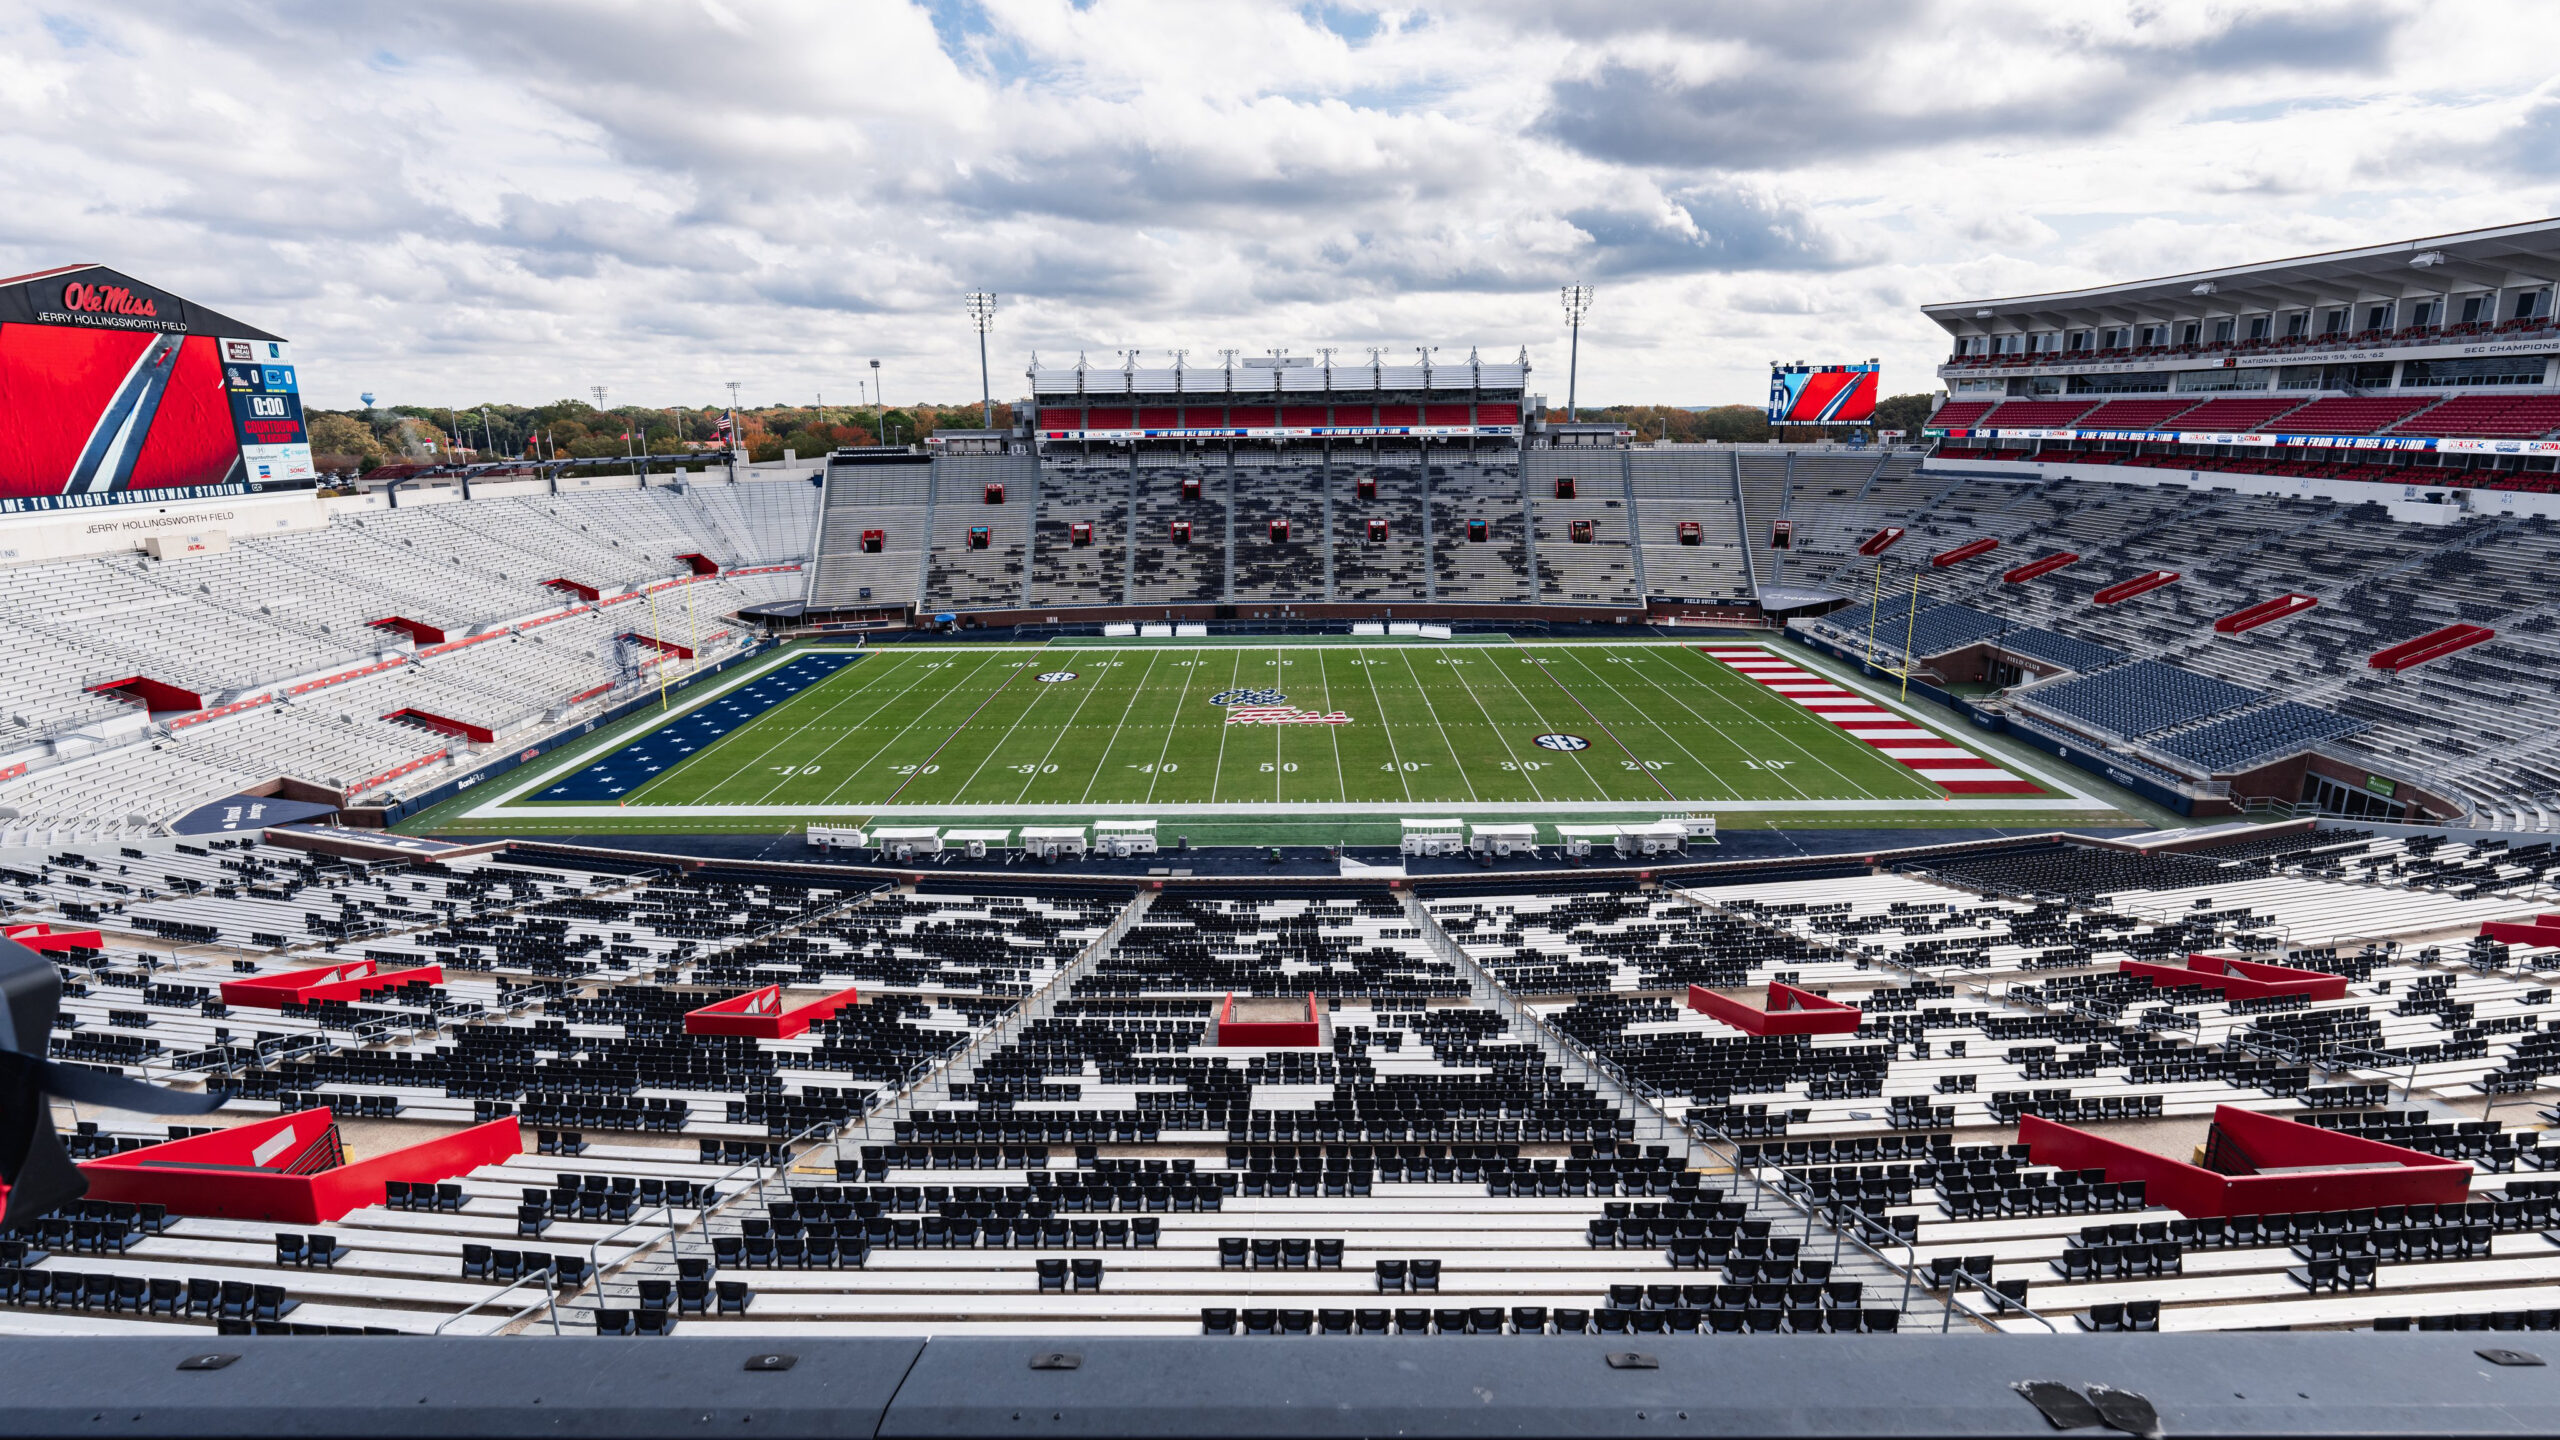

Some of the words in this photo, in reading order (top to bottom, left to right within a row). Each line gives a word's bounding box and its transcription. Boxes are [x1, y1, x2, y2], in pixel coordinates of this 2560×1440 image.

[64, 282, 102, 312] Ole
[98, 285, 157, 317] Miss
[37, 312, 72, 323] JERRY
[74, 314, 160, 329] HOLLINGSWORTH
[161, 321, 187, 331] FIELD
[2463, 346, 2486, 354] SEC
[2489, 342, 2560, 352] CHAMPIONS
[2224, 358, 2234, 367] 25
[2242, 357, 2279, 365] NATIONAL
[2281, 355, 2329, 363] CHAMPIONS
[251, 369, 259, 384] 0
[284, 371, 293, 384] 0
[253, 397, 285, 416] 0:00
[244, 420, 300, 433] COUNTDOWN
[1975, 429, 1991, 438] 0:00
[2081, 431, 2098, 439] LIVE
[2099, 432, 2116, 440] FROM
[2117, 432, 2129, 440] OLE
[2287, 436, 2306, 446] LIVE
[2307, 437, 2333, 447] FROM
[2335, 438, 2353, 448] OLE
[2354, 439, 2380, 449] MISS
[33, 496, 50, 511] TO
[57, 485, 191, 509] VAUGHT-HEMINGWAY
[195, 482, 245, 497] STADIUM
[86, 522, 119, 534] JERRY
[122, 513, 208, 529] HOLLINGSWORTH
[209, 511, 234, 521] FIELD
[2007, 655, 2024, 665] FIELD
[2025, 662, 2040, 671] CLUB
[1037, 672, 1074, 682] SEC
[1209, 689, 1287, 706] Ole
[1225, 705, 1354, 724] Miss
[1536, 734, 1588, 750] SEC
[777, 765, 822, 775] 10
[897, 764, 940, 775] 20
[1018, 764, 1059, 774] 30
[1139, 763, 1178, 773] 40
[1259, 762, 1298, 773] 50
[1380, 762, 1419, 772] 40
[1500, 761, 1541, 771] 30
[1621, 760, 1663, 771] 20
[1740, 760, 1786, 770] 10
